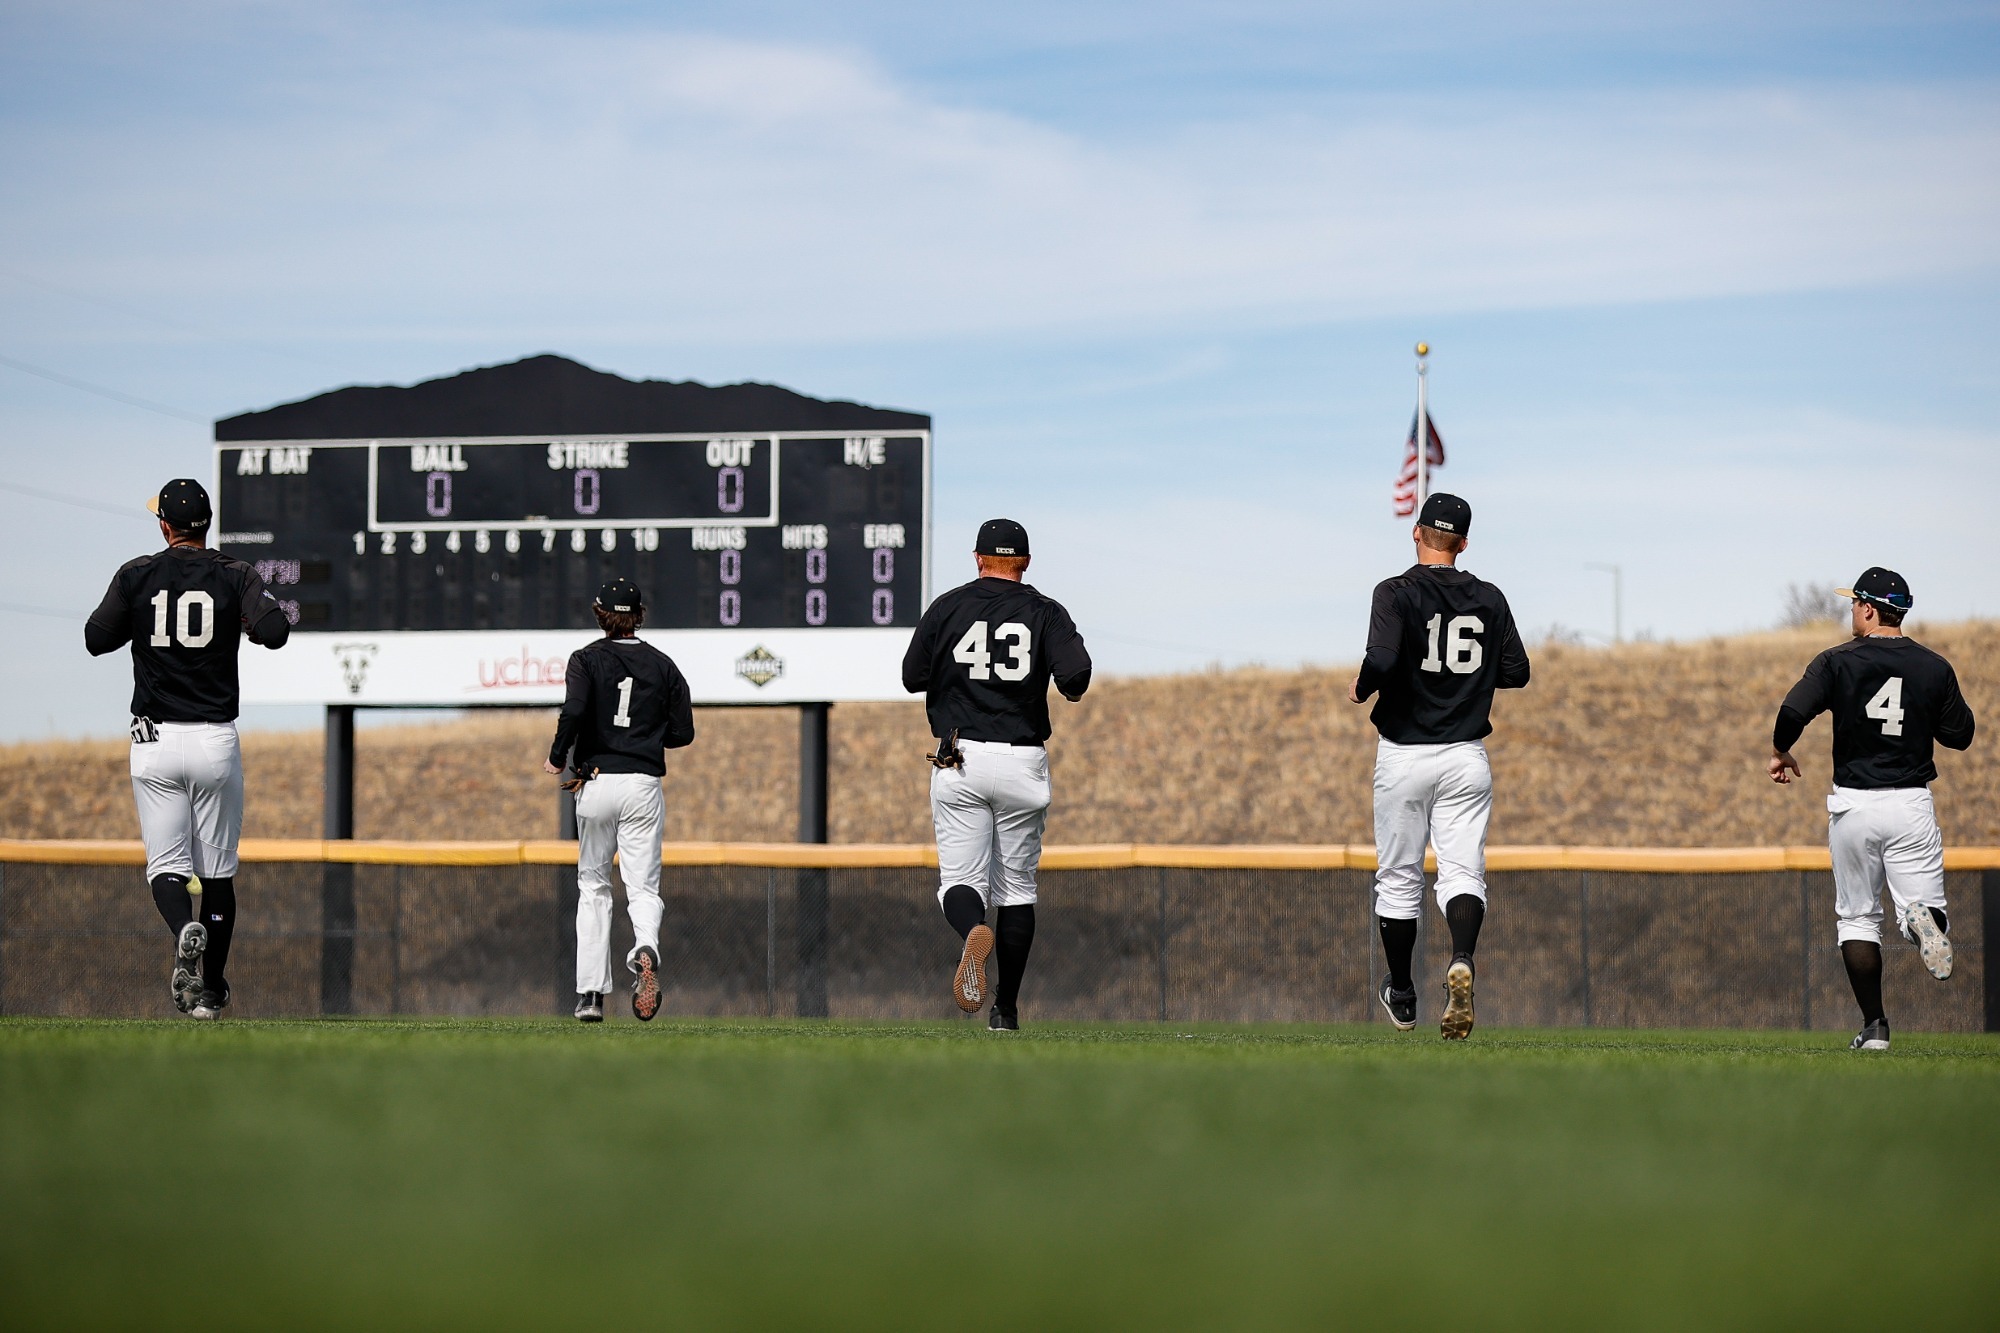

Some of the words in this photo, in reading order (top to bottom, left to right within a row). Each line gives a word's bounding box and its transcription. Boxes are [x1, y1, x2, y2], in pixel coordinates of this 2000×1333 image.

[237, 449, 267, 475] AT
[269, 448, 312, 475] BAT
[411, 445, 468, 472] BALL
[547, 442, 629, 470] STRIKE
[706, 440, 755, 467] OUT
[844, 438, 886, 467] H/E
[427, 471, 452, 517] 0
[574, 468, 600, 515] 0
[717, 466, 745, 513] 0
[353, 530, 366, 555] 1
[381, 531, 397, 555] 2
[410, 531, 427, 555] 3
[446, 531, 461, 554] 4
[475, 529, 491, 553] 5
[505, 529, 521, 553] 6
[541, 529, 556, 552] 7
[570, 528, 586, 553] 8
[601, 528, 617, 552] 9
[631, 528, 659, 552] 10
[691, 527, 747, 550] RUNS
[781, 524, 828, 549] HITS
[863, 523, 905, 549] ERR
[720, 549, 741, 585] 0
[806, 549, 827, 584] 0
[872, 548, 894, 584] 0
[151, 590, 213, 647] 10
[719, 589, 741, 626] 0
[805, 588, 827, 626] 0
[872, 588, 894, 625] 0
[953, 621, 1031, 681] 43
[1421, 614, 1484, 673] 16
[614, 677, 633, 727] 1
[1865, 677, 1904, 736] 4
